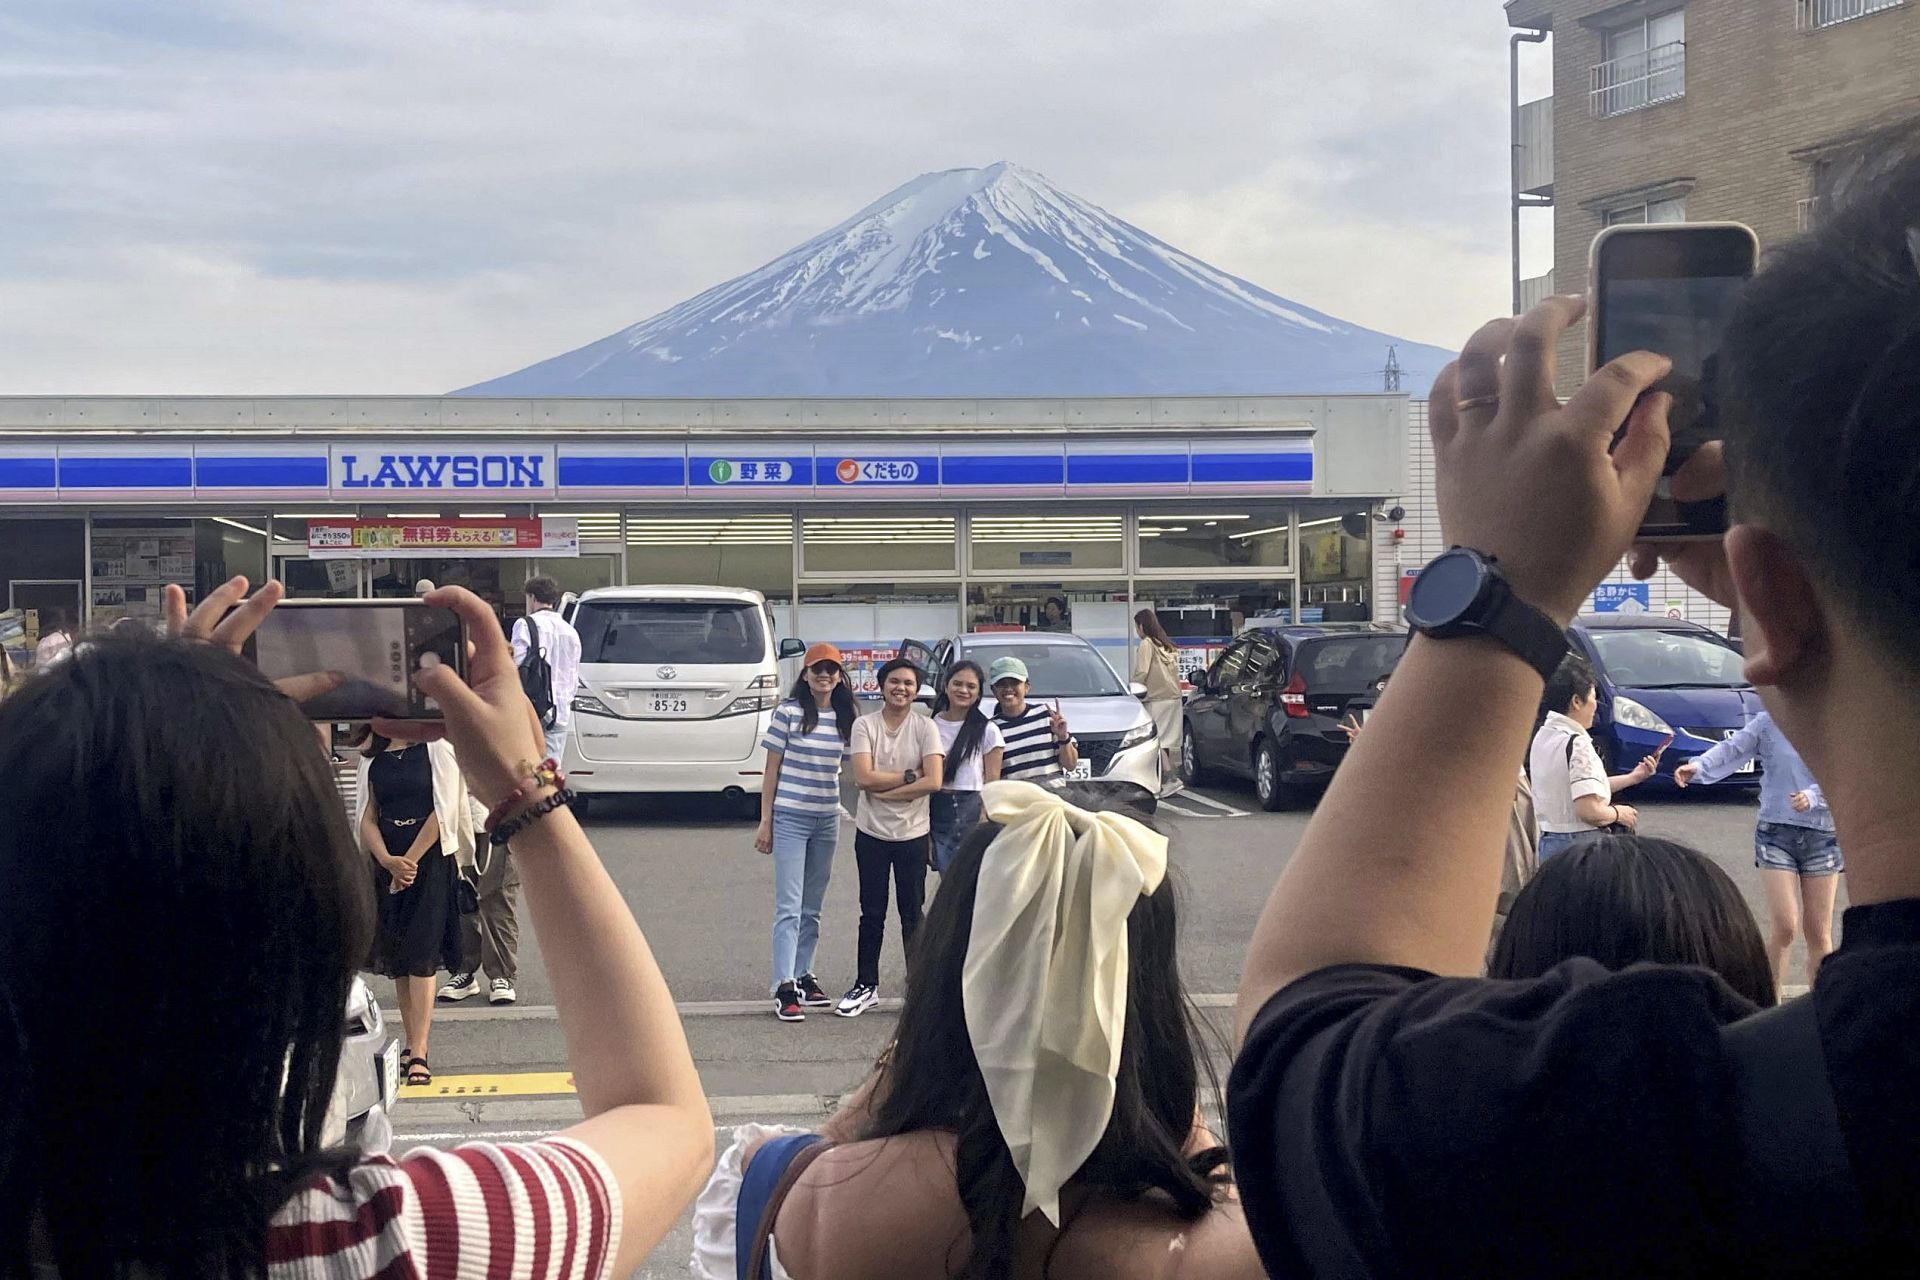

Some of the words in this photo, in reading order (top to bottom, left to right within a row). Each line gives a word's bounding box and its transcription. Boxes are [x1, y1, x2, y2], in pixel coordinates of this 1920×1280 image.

[341, 455, 544, 488] LAWSON
[740, 462, 782, 480] 野菜
[862, 462, 914, 480] くだもの
[654, 700, 687, 712] 85-29
